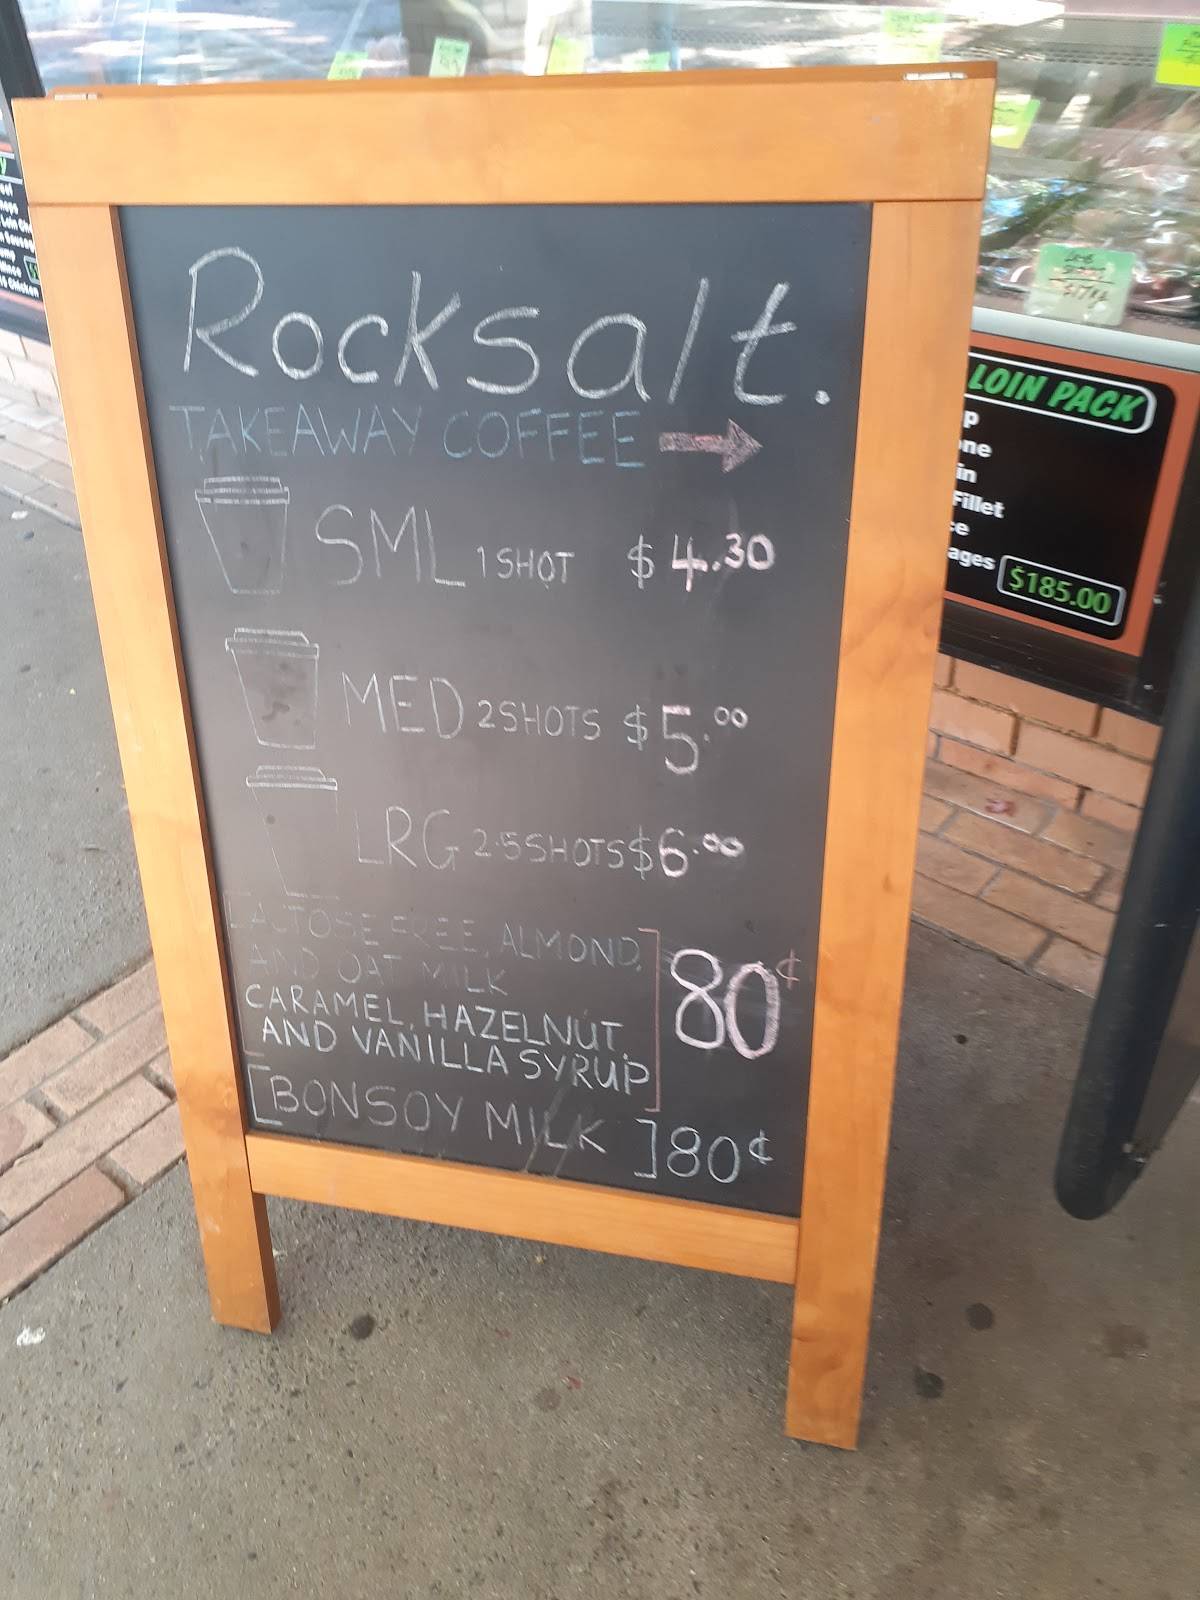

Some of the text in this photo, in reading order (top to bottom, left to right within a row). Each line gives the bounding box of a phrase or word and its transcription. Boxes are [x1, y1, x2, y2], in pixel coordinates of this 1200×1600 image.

[968, 363, 1146, 423] LOIN PACK
[169, 403, 646, 468] TAKEAWAY COFFEE
[953, 489, 1005, 519] Fillet
[315, 503, 466, 588] SML
[1008, 565, 1113, 616] $185.00
[340, 671, 465, 740] MED
[354, 804, 460, 872] LRG
[262, 1015, 650, 1095] AND VANILLA SYRUP
[423, 1000, 625, 1051] HAZELNUT
[269, 1073, 607, 1154] BONSOY MILK
